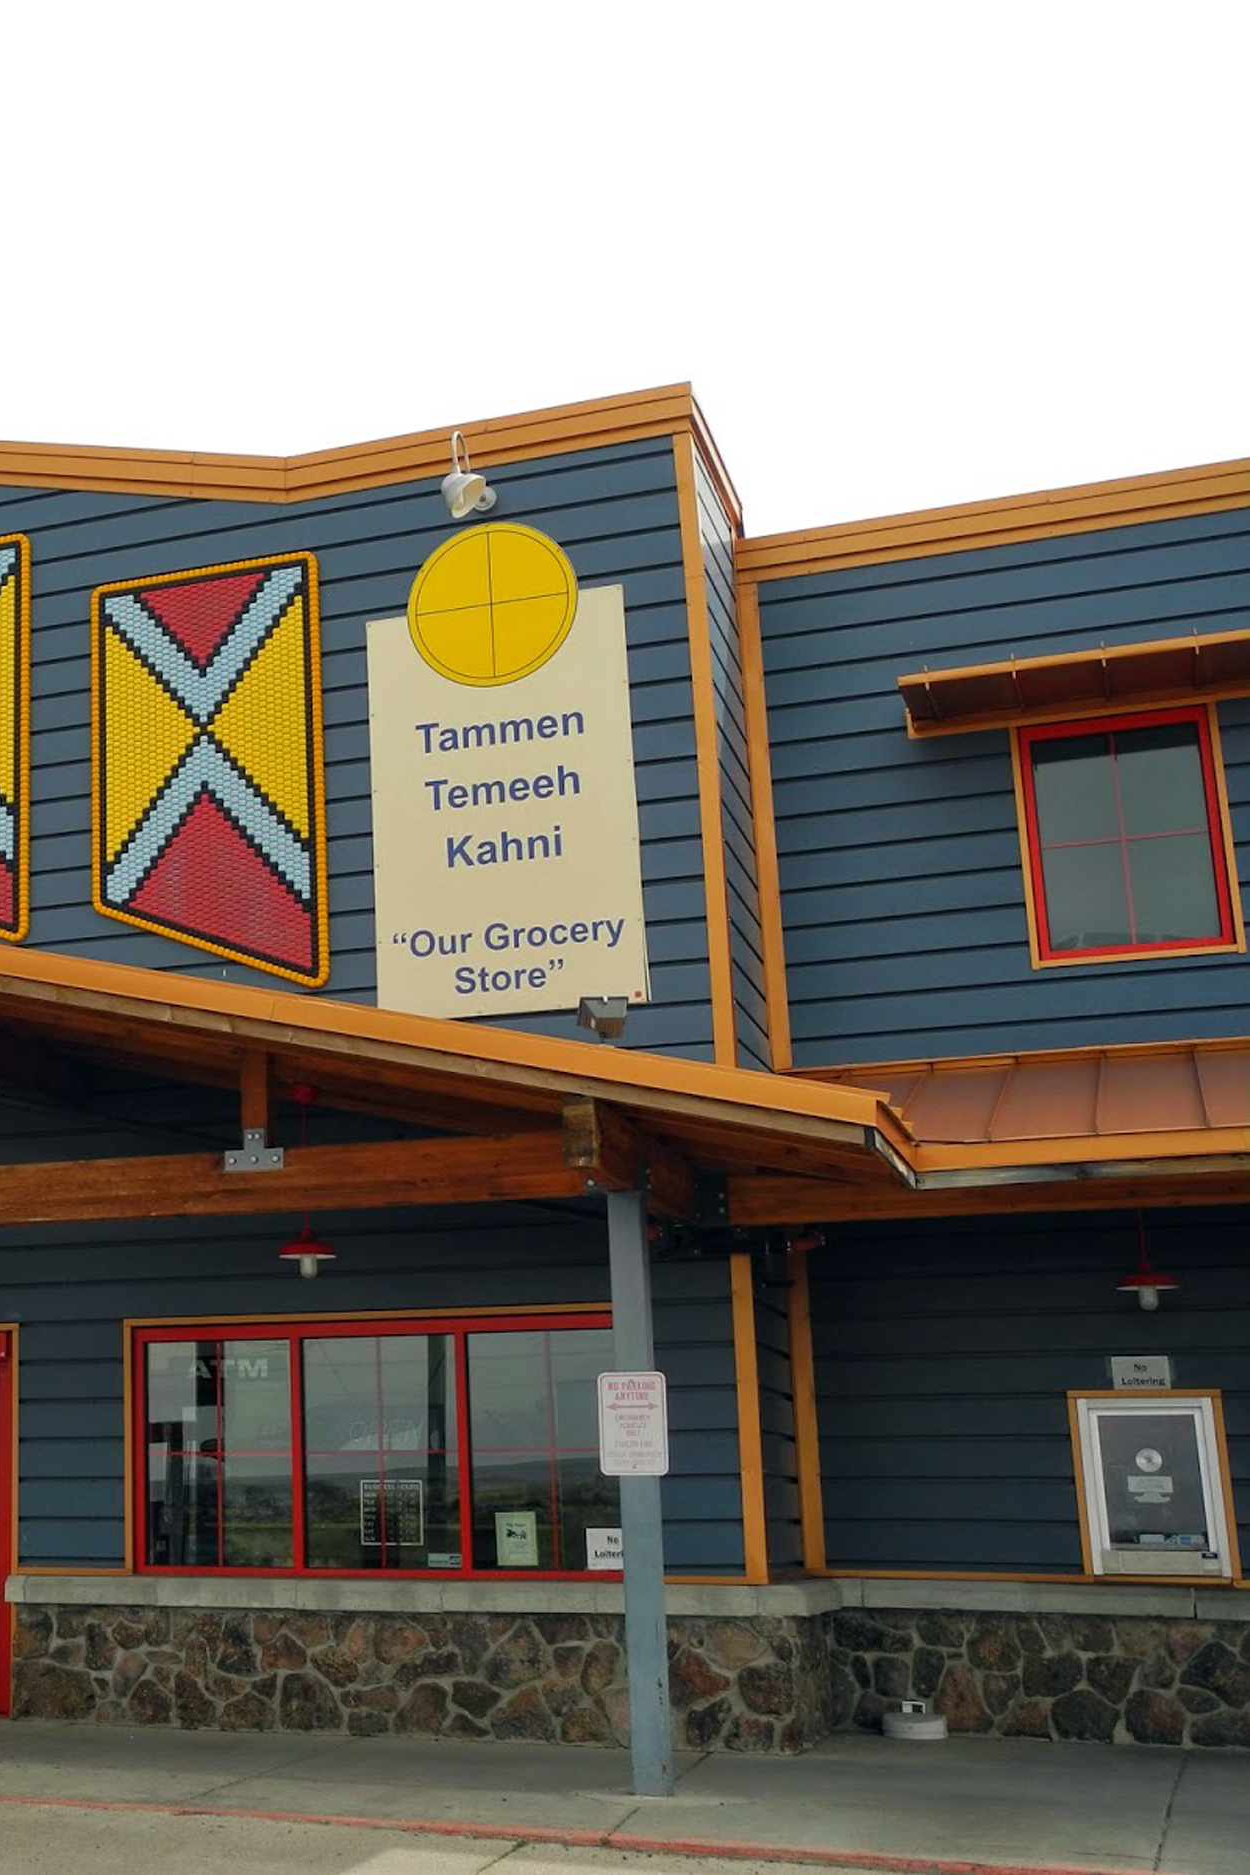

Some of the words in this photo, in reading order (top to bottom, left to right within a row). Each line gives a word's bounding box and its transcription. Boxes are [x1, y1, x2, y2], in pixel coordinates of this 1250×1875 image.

[415, 711, 584, 753] Tammen
[424, 765, 580, 810] Temeeh
[446, 825, 562, 868] Kahni
[393, 930, 473, 957] “Our
[484, 918, 624, 951] Grocery
[455, 959, 564, 994] Store”
[187, 1359, 268, 1379] ATM
[1133, 1363, 1148, 1372] No
[607, 1381, 619, 1391] NO
[621, 1381, 656, 1391] PARKING
[1121, 1377, 1166, 1386] Loitering
[615, 1391, 649, 1401] ANYTIME
[606, 1535, 619, 1544] No
